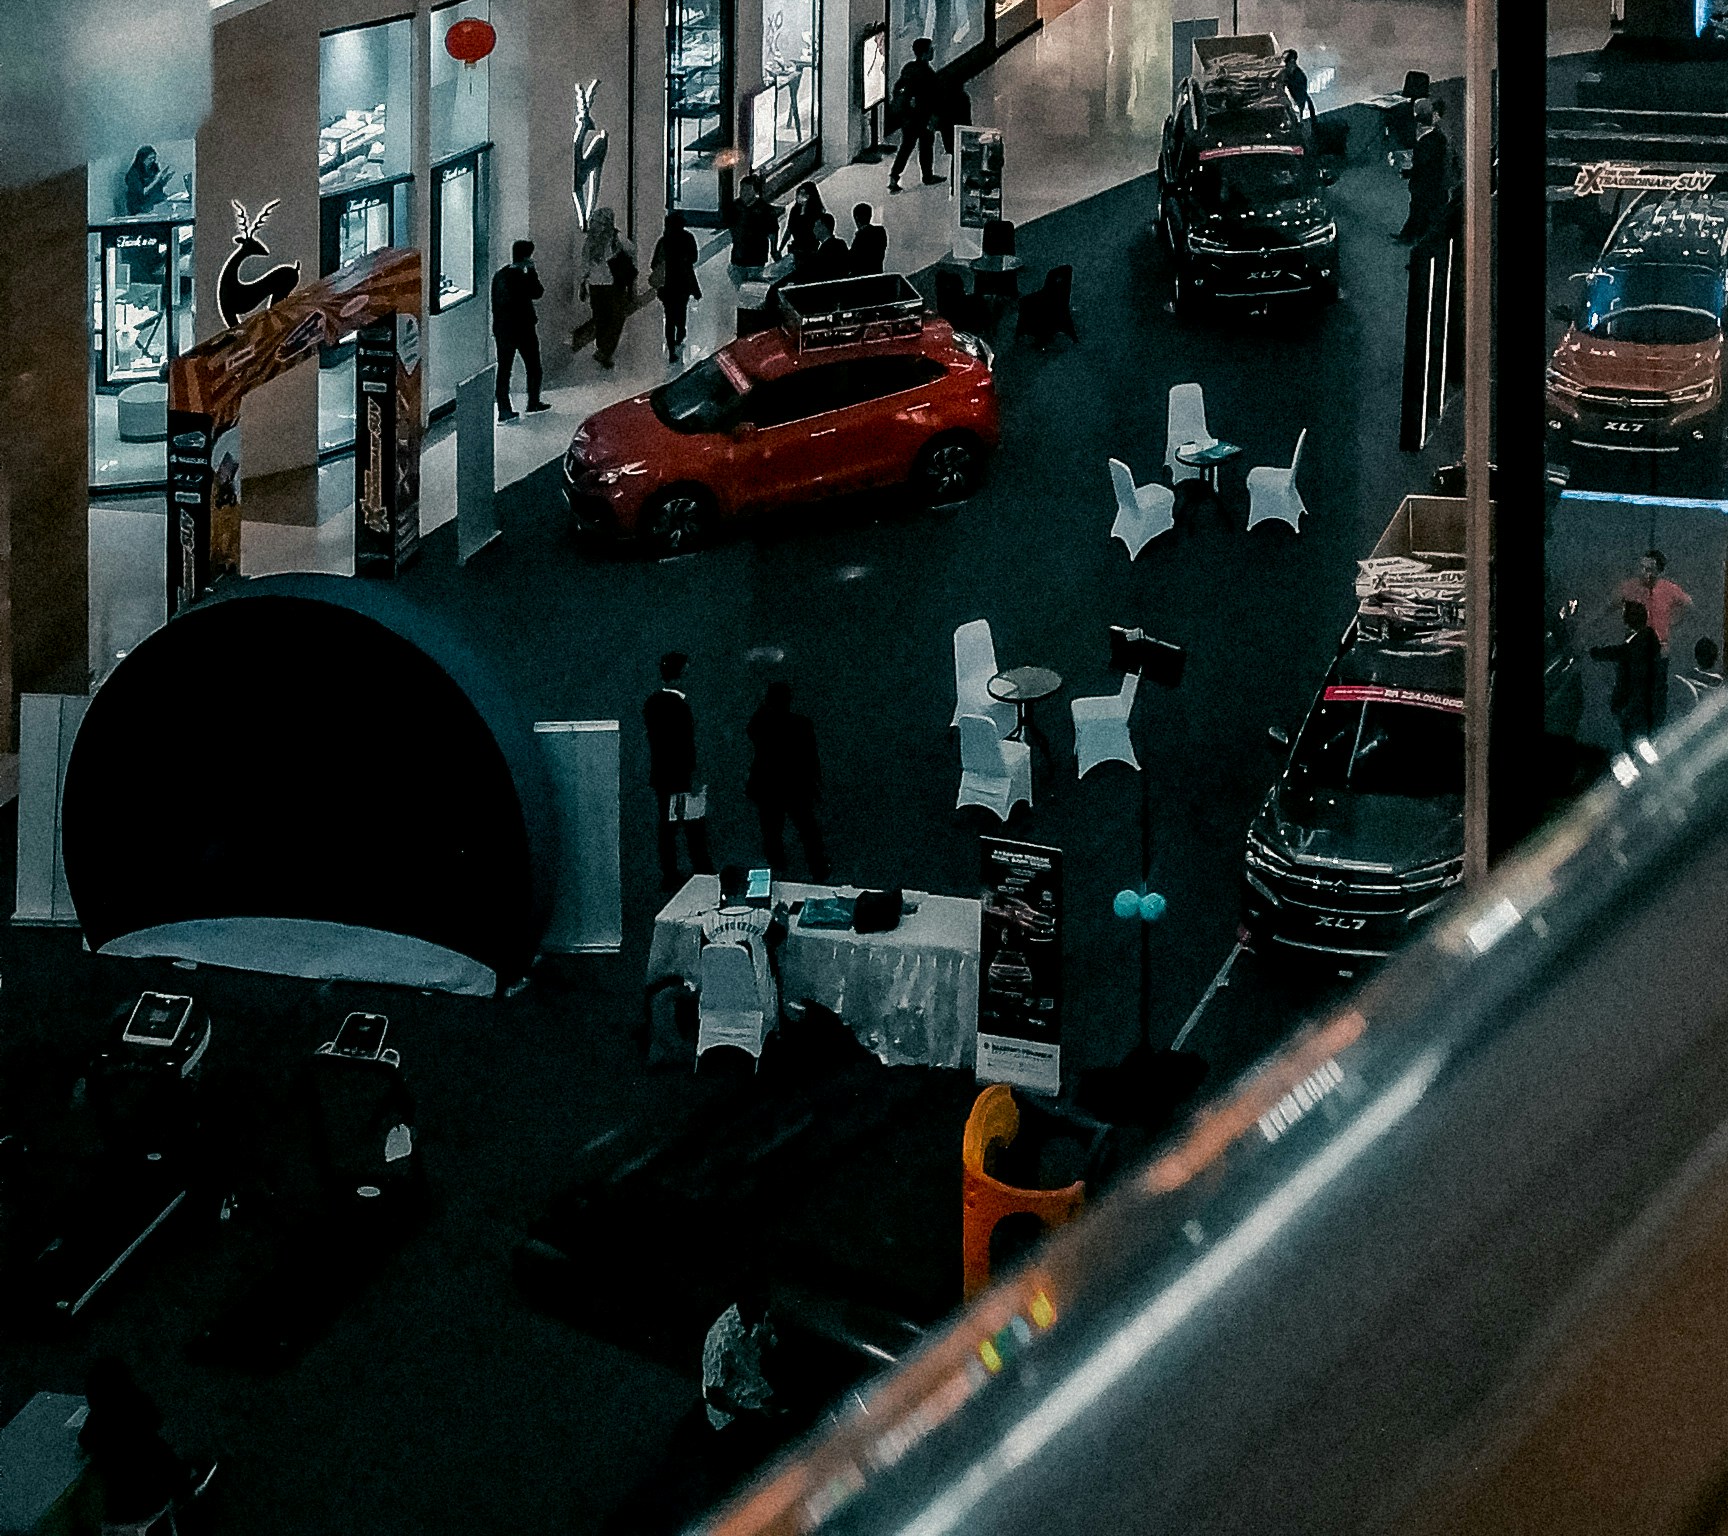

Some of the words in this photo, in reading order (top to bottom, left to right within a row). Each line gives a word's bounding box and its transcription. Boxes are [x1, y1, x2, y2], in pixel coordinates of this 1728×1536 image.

[1675, 173, 1716, 191] SUV
[1603, 421, 1645, 432] XL7
[1315, 915, 1367, 930] XL7
